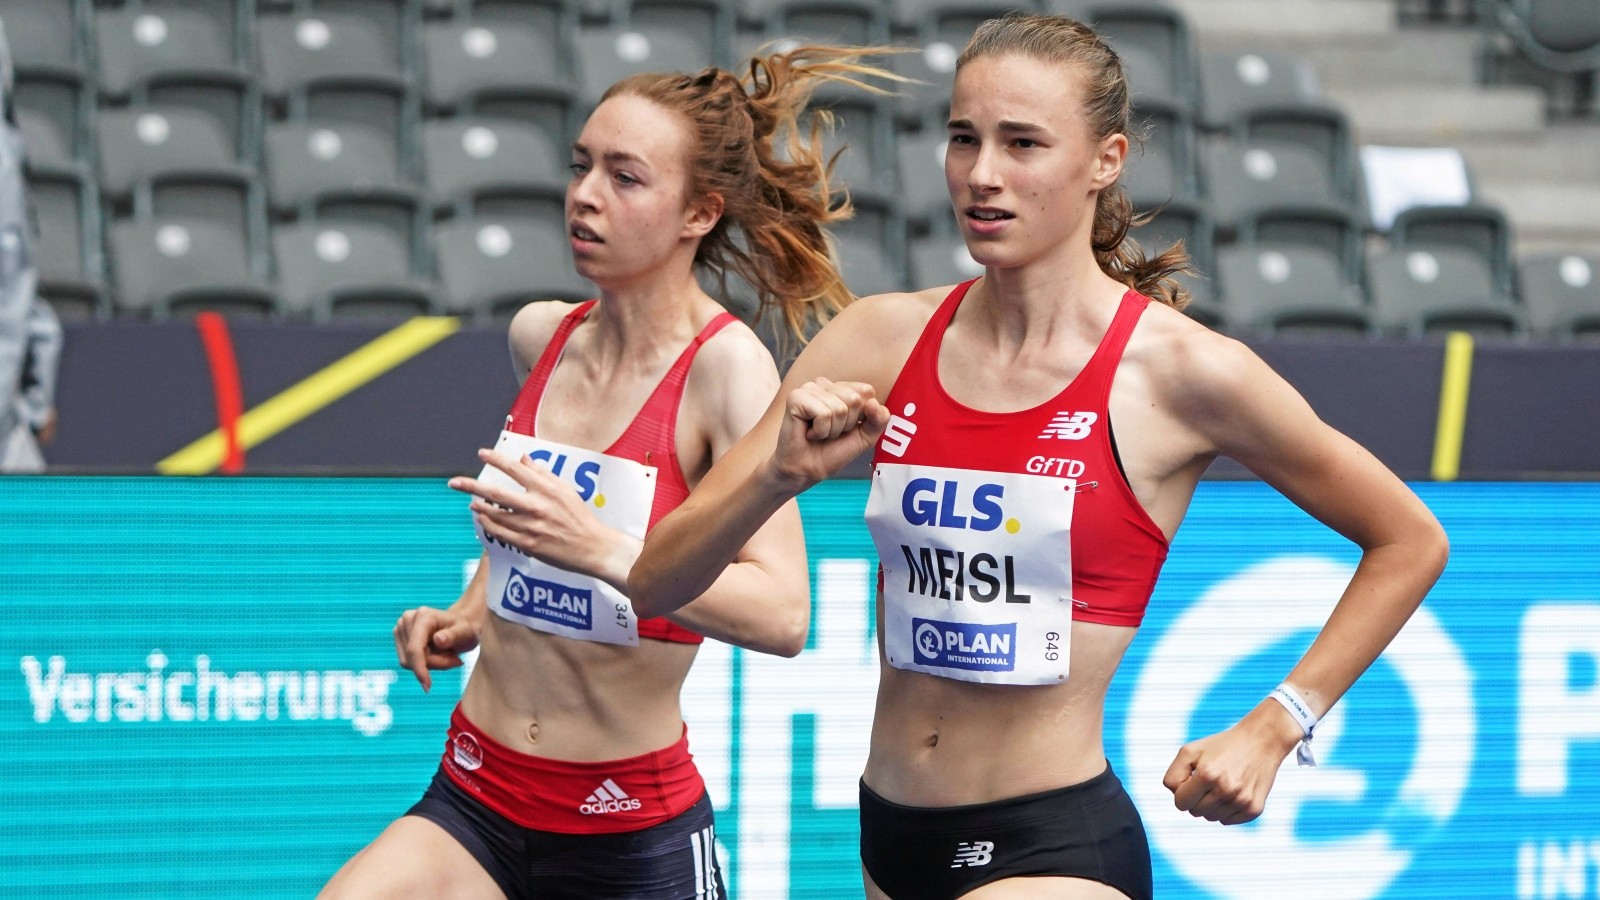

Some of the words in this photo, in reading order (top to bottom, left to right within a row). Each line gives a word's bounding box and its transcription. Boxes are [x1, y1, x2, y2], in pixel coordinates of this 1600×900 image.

[1026, 455, 1085, 478] GfTD
[901, 545, 1031, 604] MEISL
[533, 586, 588, 616] PLAN
[533, 606, 587, 626] INTERNATIONAL
[615, 603, 628, 629] 347
[946, 631, 1010, 655] PLAN
[1045, 631, 1059, 662] 649
[947, 654, 1009, 666] INTERNATIONAL
[20, 649, 397, 736] Versicherung
[579, 796, 642, 815] adidas
